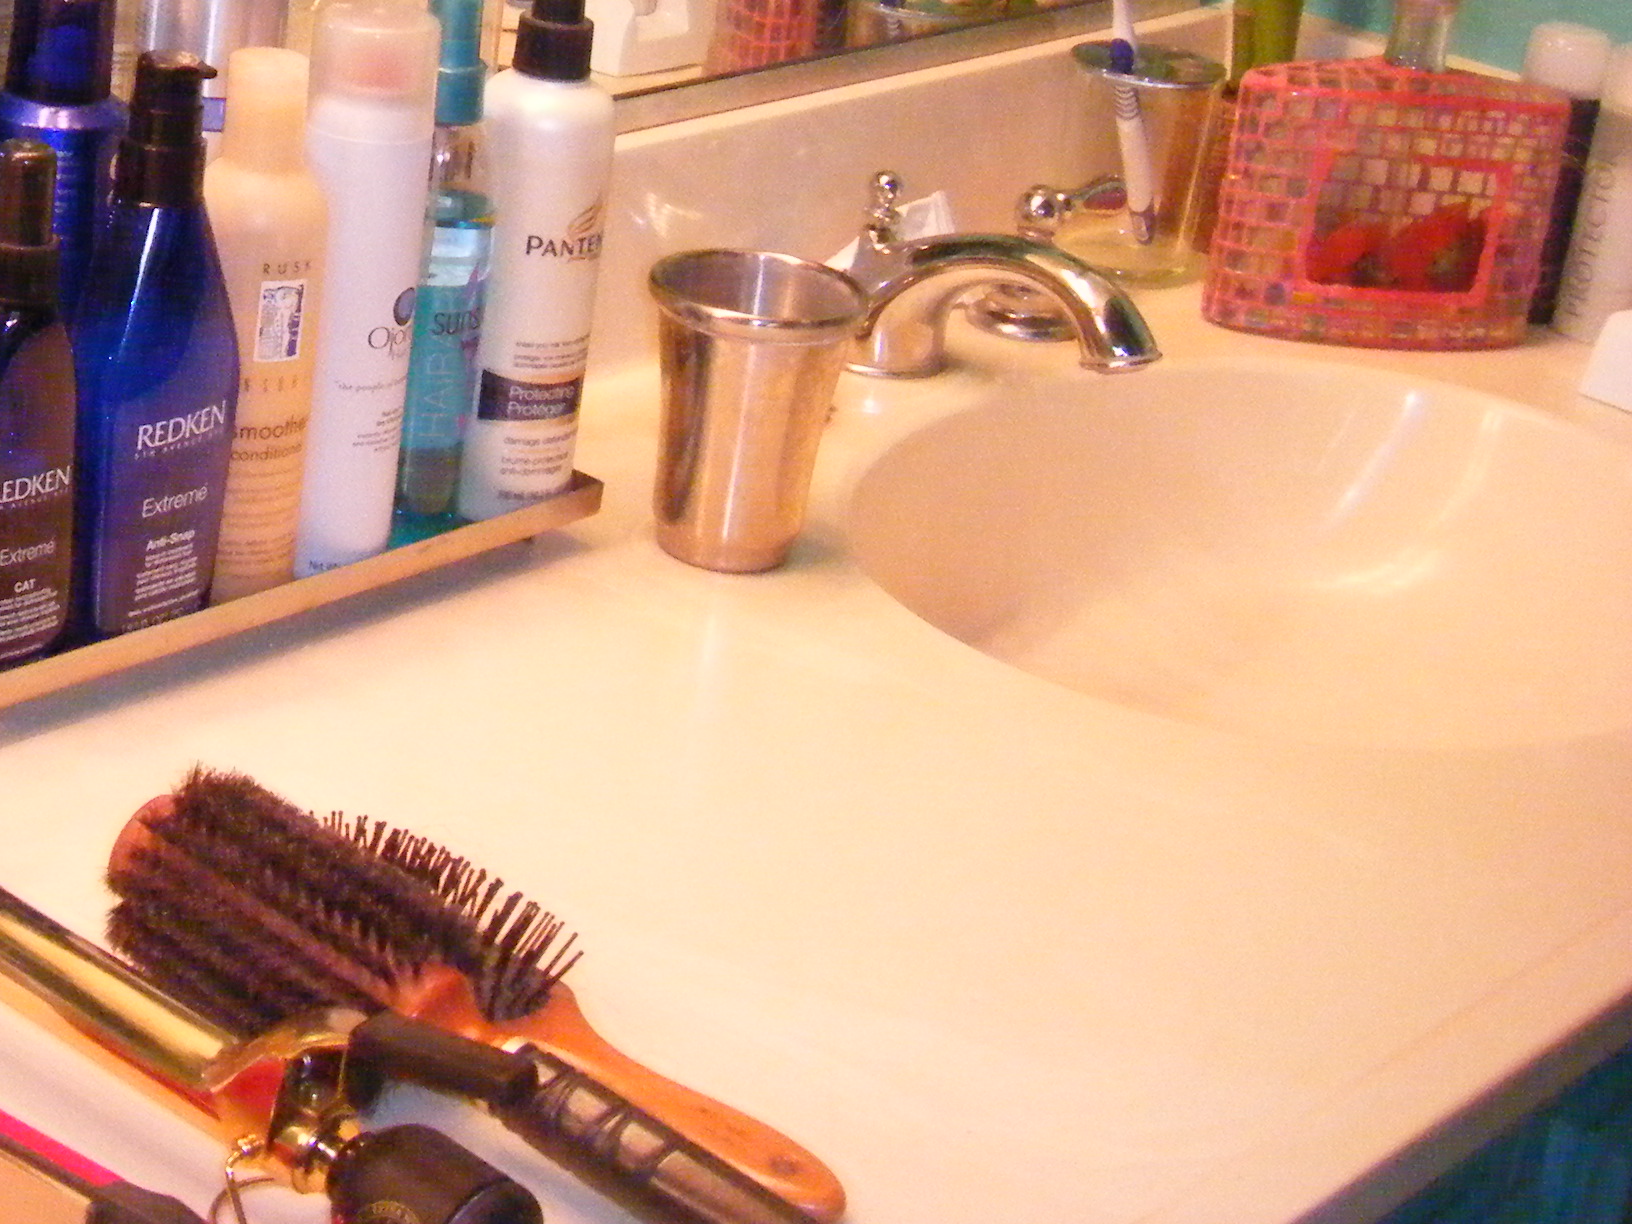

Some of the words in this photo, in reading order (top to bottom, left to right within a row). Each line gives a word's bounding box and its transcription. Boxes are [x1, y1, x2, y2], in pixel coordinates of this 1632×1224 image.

[136, 400, 227, 451] REDKEN
[229, 442, 304, 462] conditione
[141, 484, 208, 518] Extreme
[0, 540, 55, 566] Extreme
[14, 579, 36, 593] CAT
